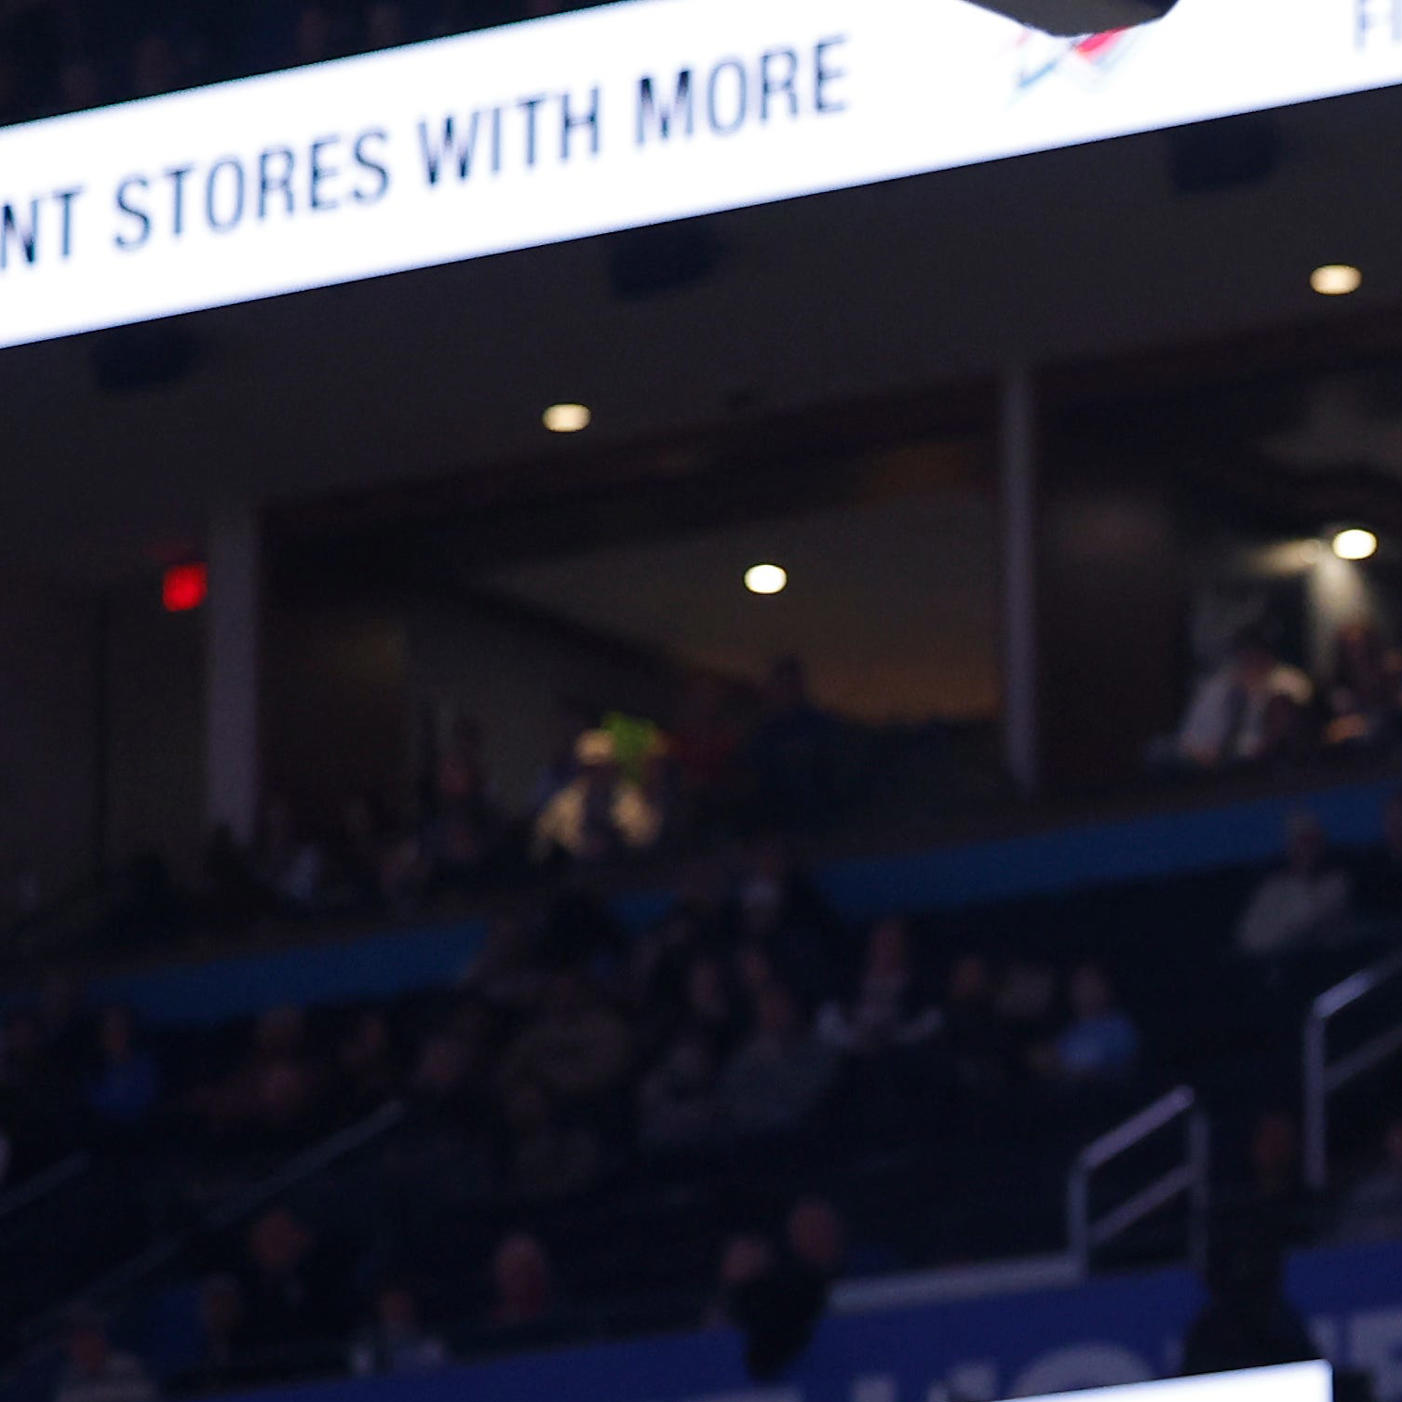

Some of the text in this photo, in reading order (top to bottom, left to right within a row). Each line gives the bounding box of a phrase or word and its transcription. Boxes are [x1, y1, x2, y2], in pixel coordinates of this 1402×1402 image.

[113, 128, 391, 252] STORES
[416, 86, 604, 190] WITH
[633, 34, 850, 150] MORE
